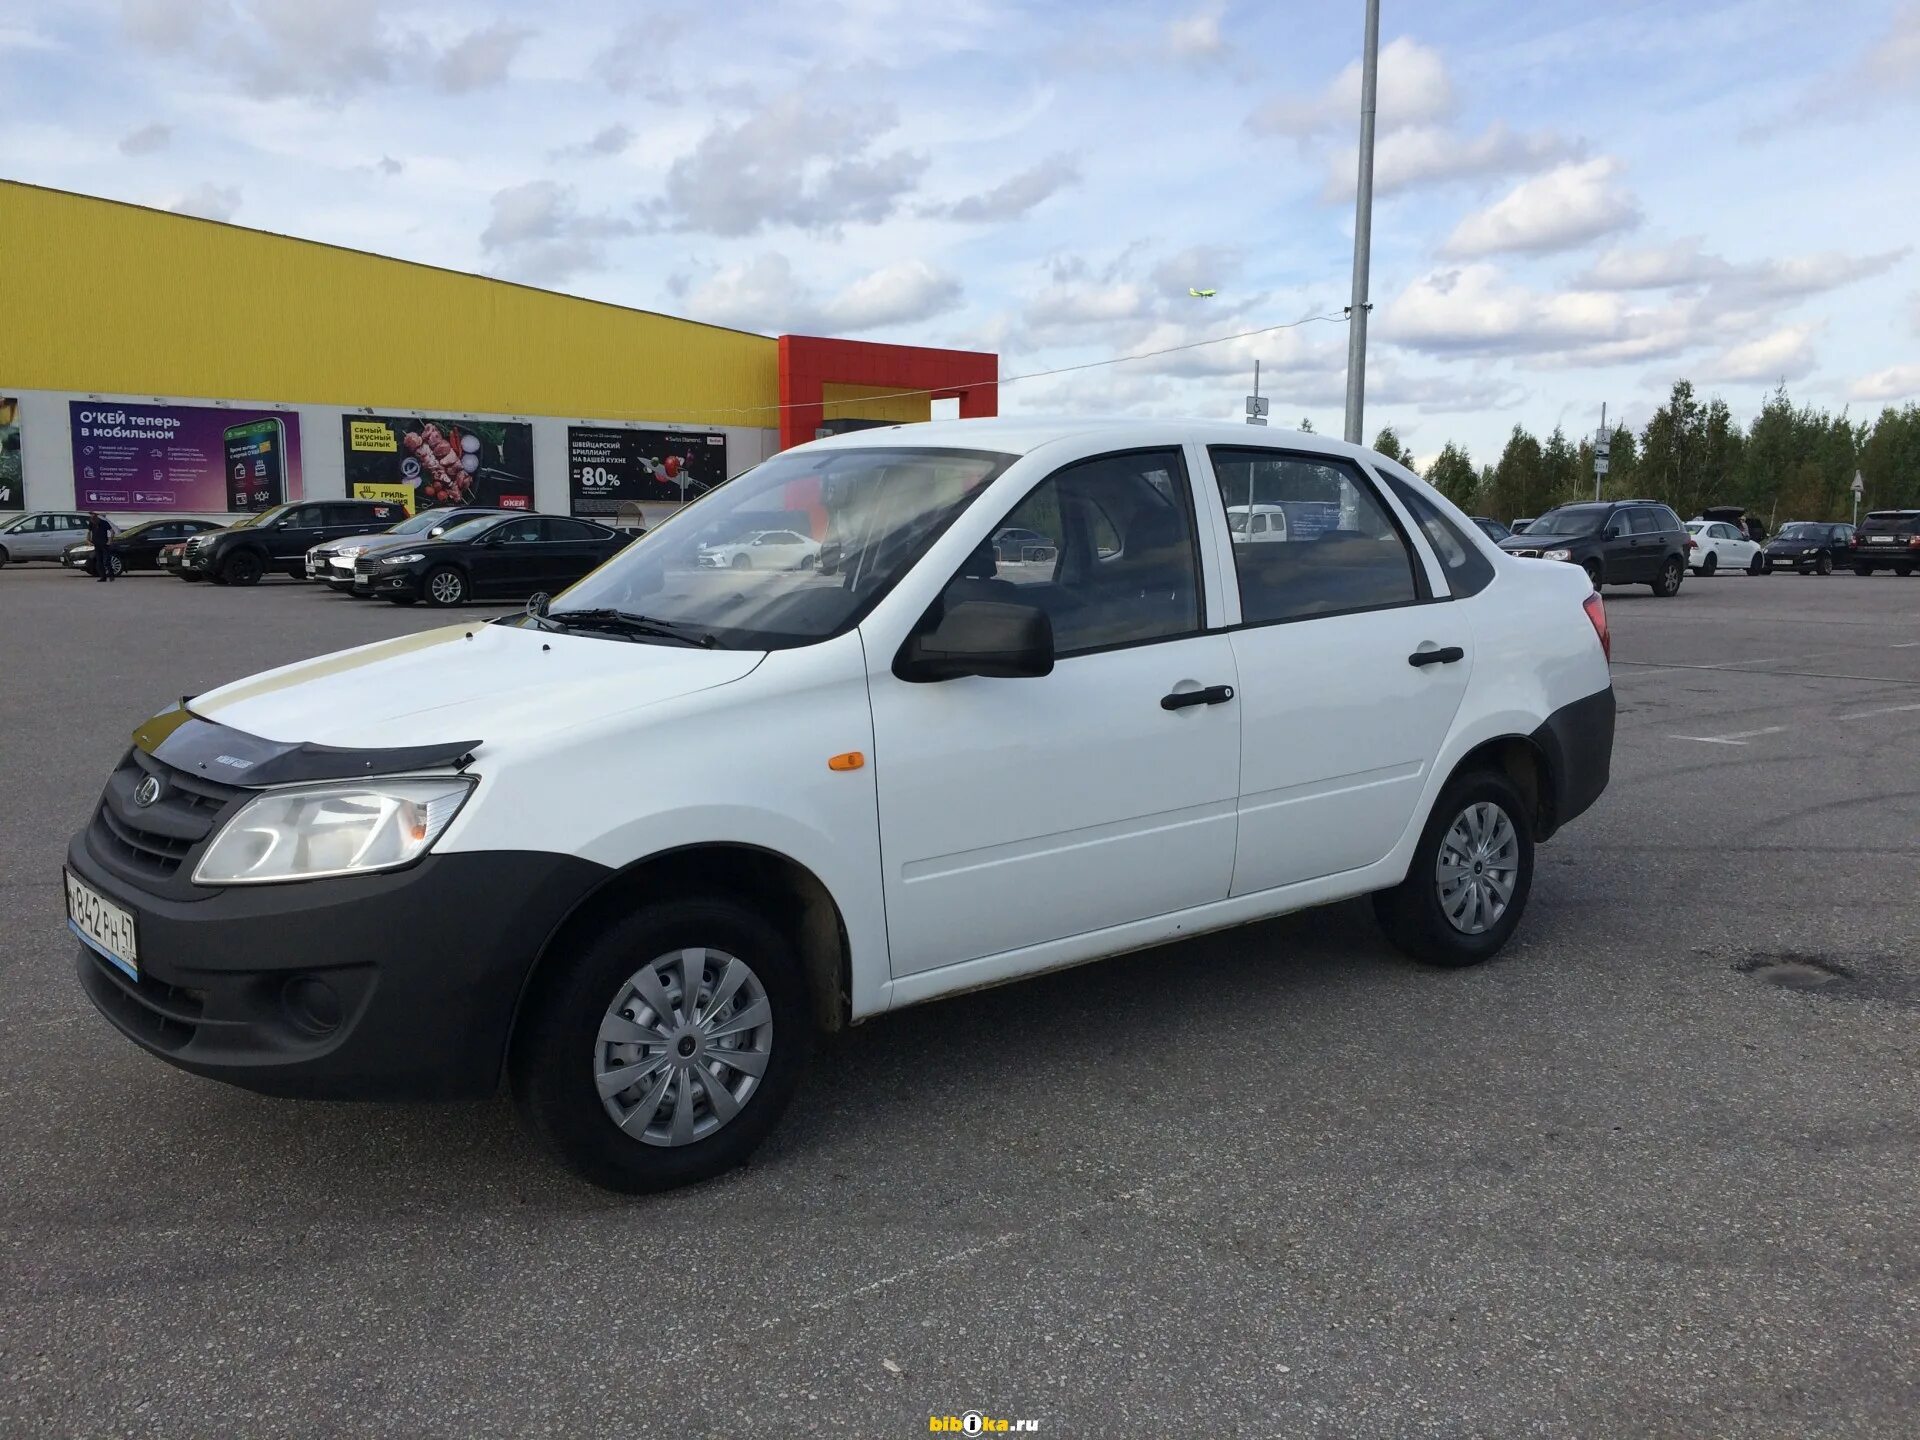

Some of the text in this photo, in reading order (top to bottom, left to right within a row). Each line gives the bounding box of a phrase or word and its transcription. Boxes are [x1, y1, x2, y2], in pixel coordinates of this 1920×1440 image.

[80, 410, 181, 430] О'КЕЙ теперь
[81, 426, 174, 440] в мобильном
[354, 426, 382, 434] самый
[354, 433, 392, 442] вкусный
[572, 440, 621, 449] ШВЕЙЦАРСКИЙ
[572, 448, 612, 456] БРИЛЛИАНТ
[380, 491, 408, 499] ГРИЛЬ-
